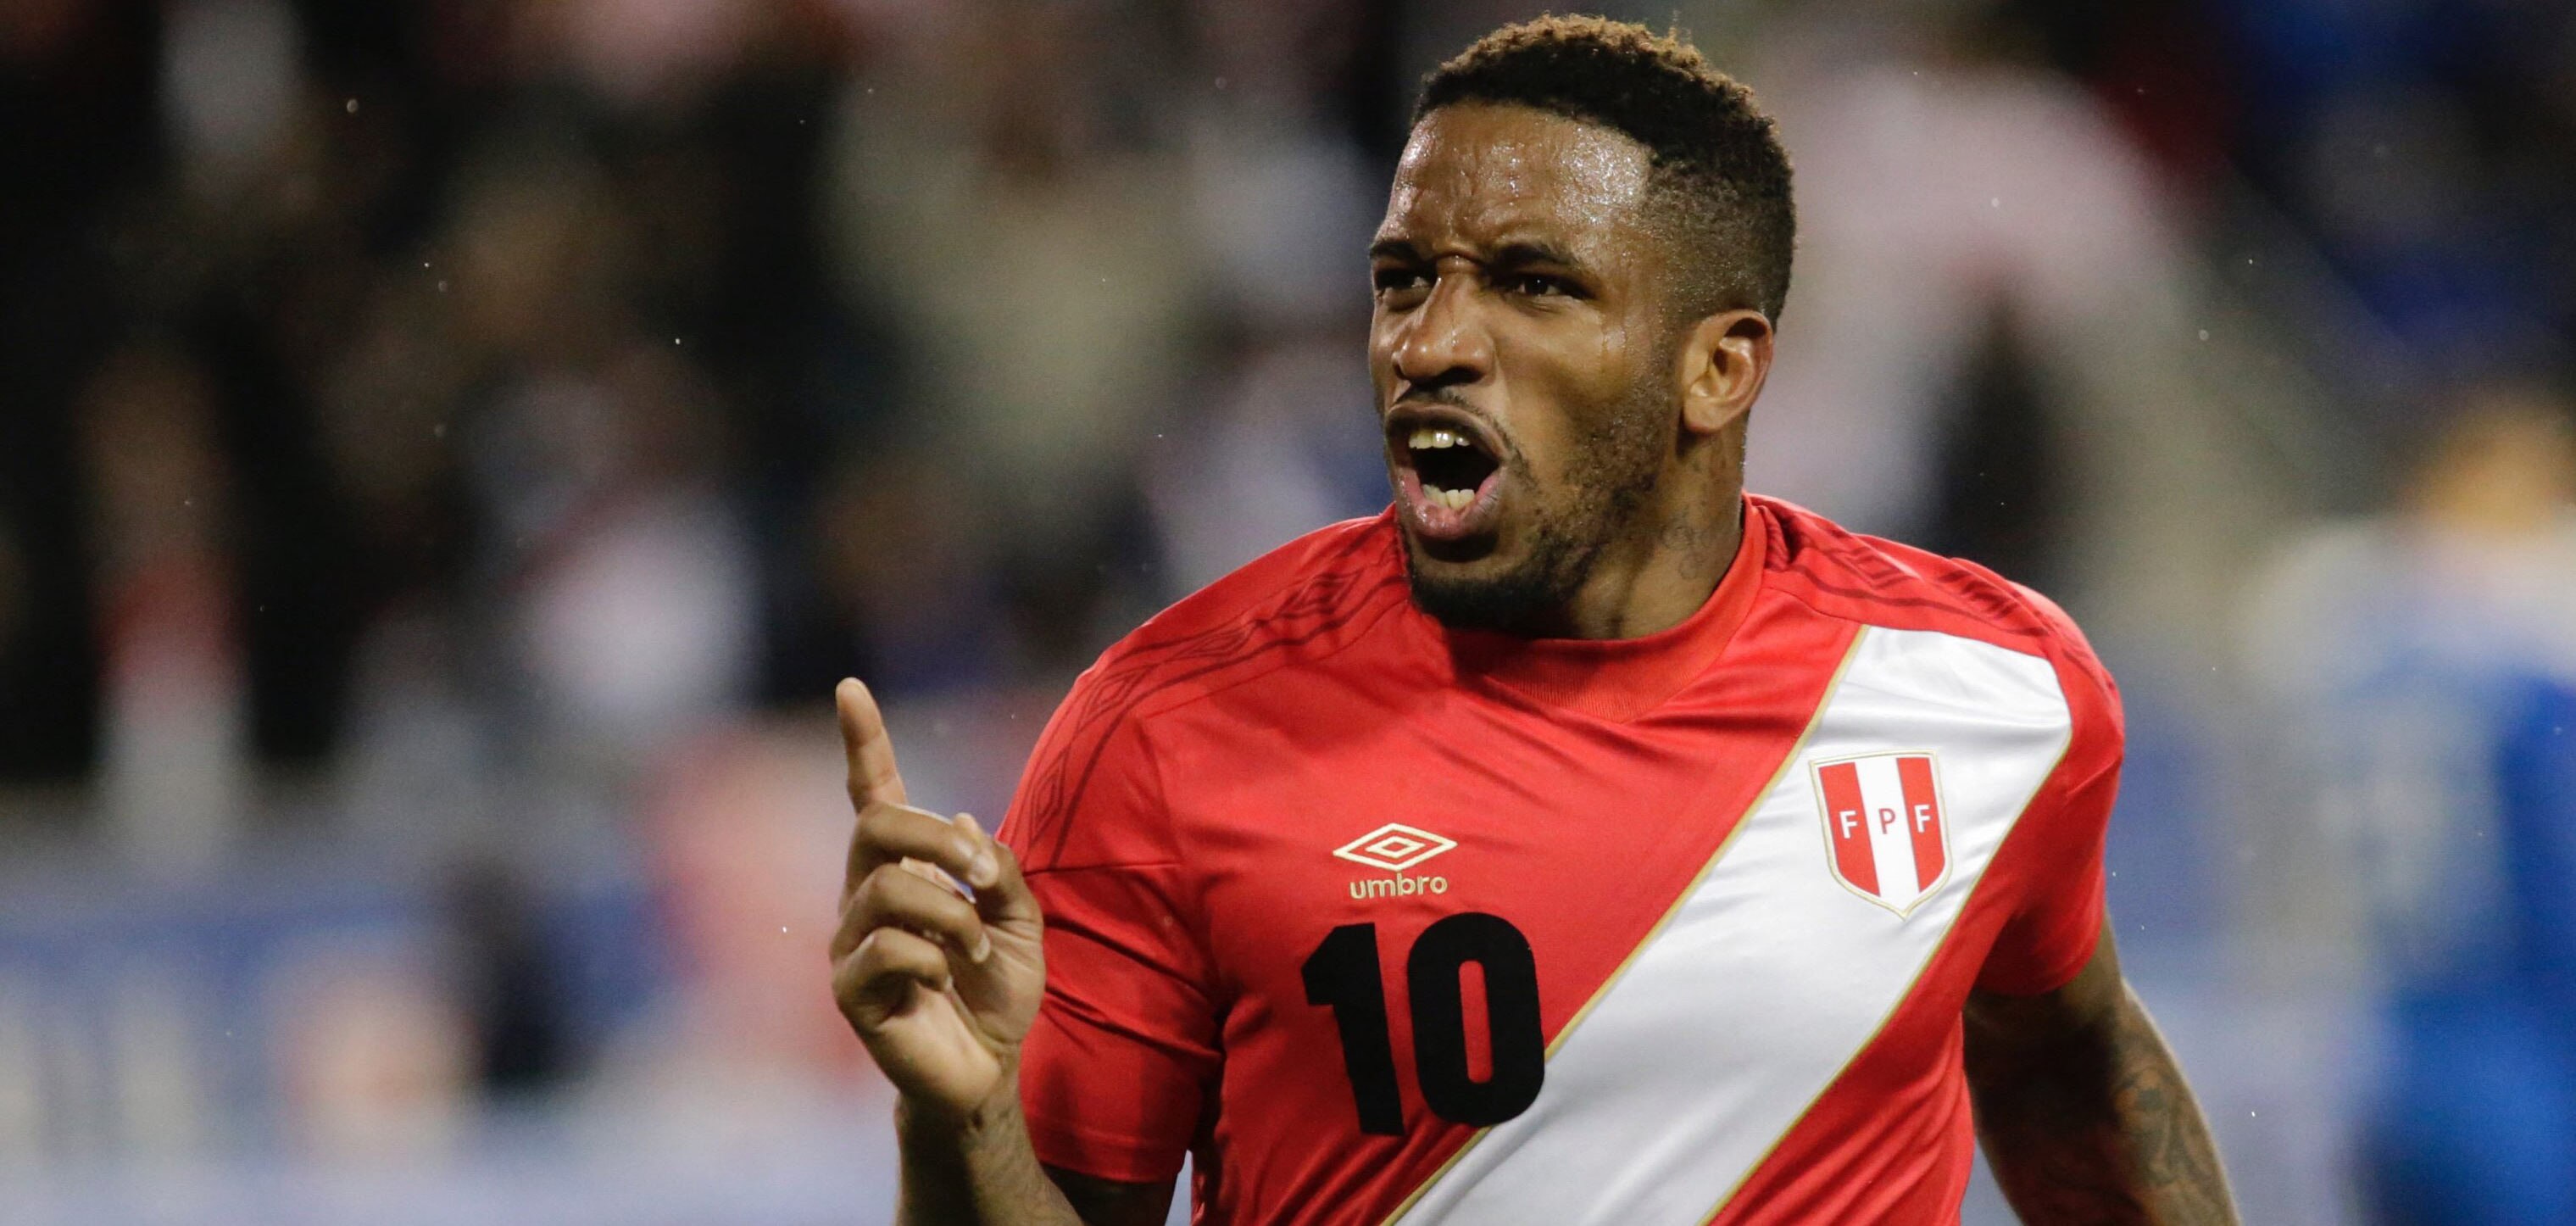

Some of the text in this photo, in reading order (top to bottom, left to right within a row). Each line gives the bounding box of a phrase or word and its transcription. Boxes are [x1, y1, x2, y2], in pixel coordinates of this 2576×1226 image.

[1839, 803, 1932, 839] FPF
[1349, 873, 1449, 899] umbro
[1301, 911, 1545, 1136] 10
